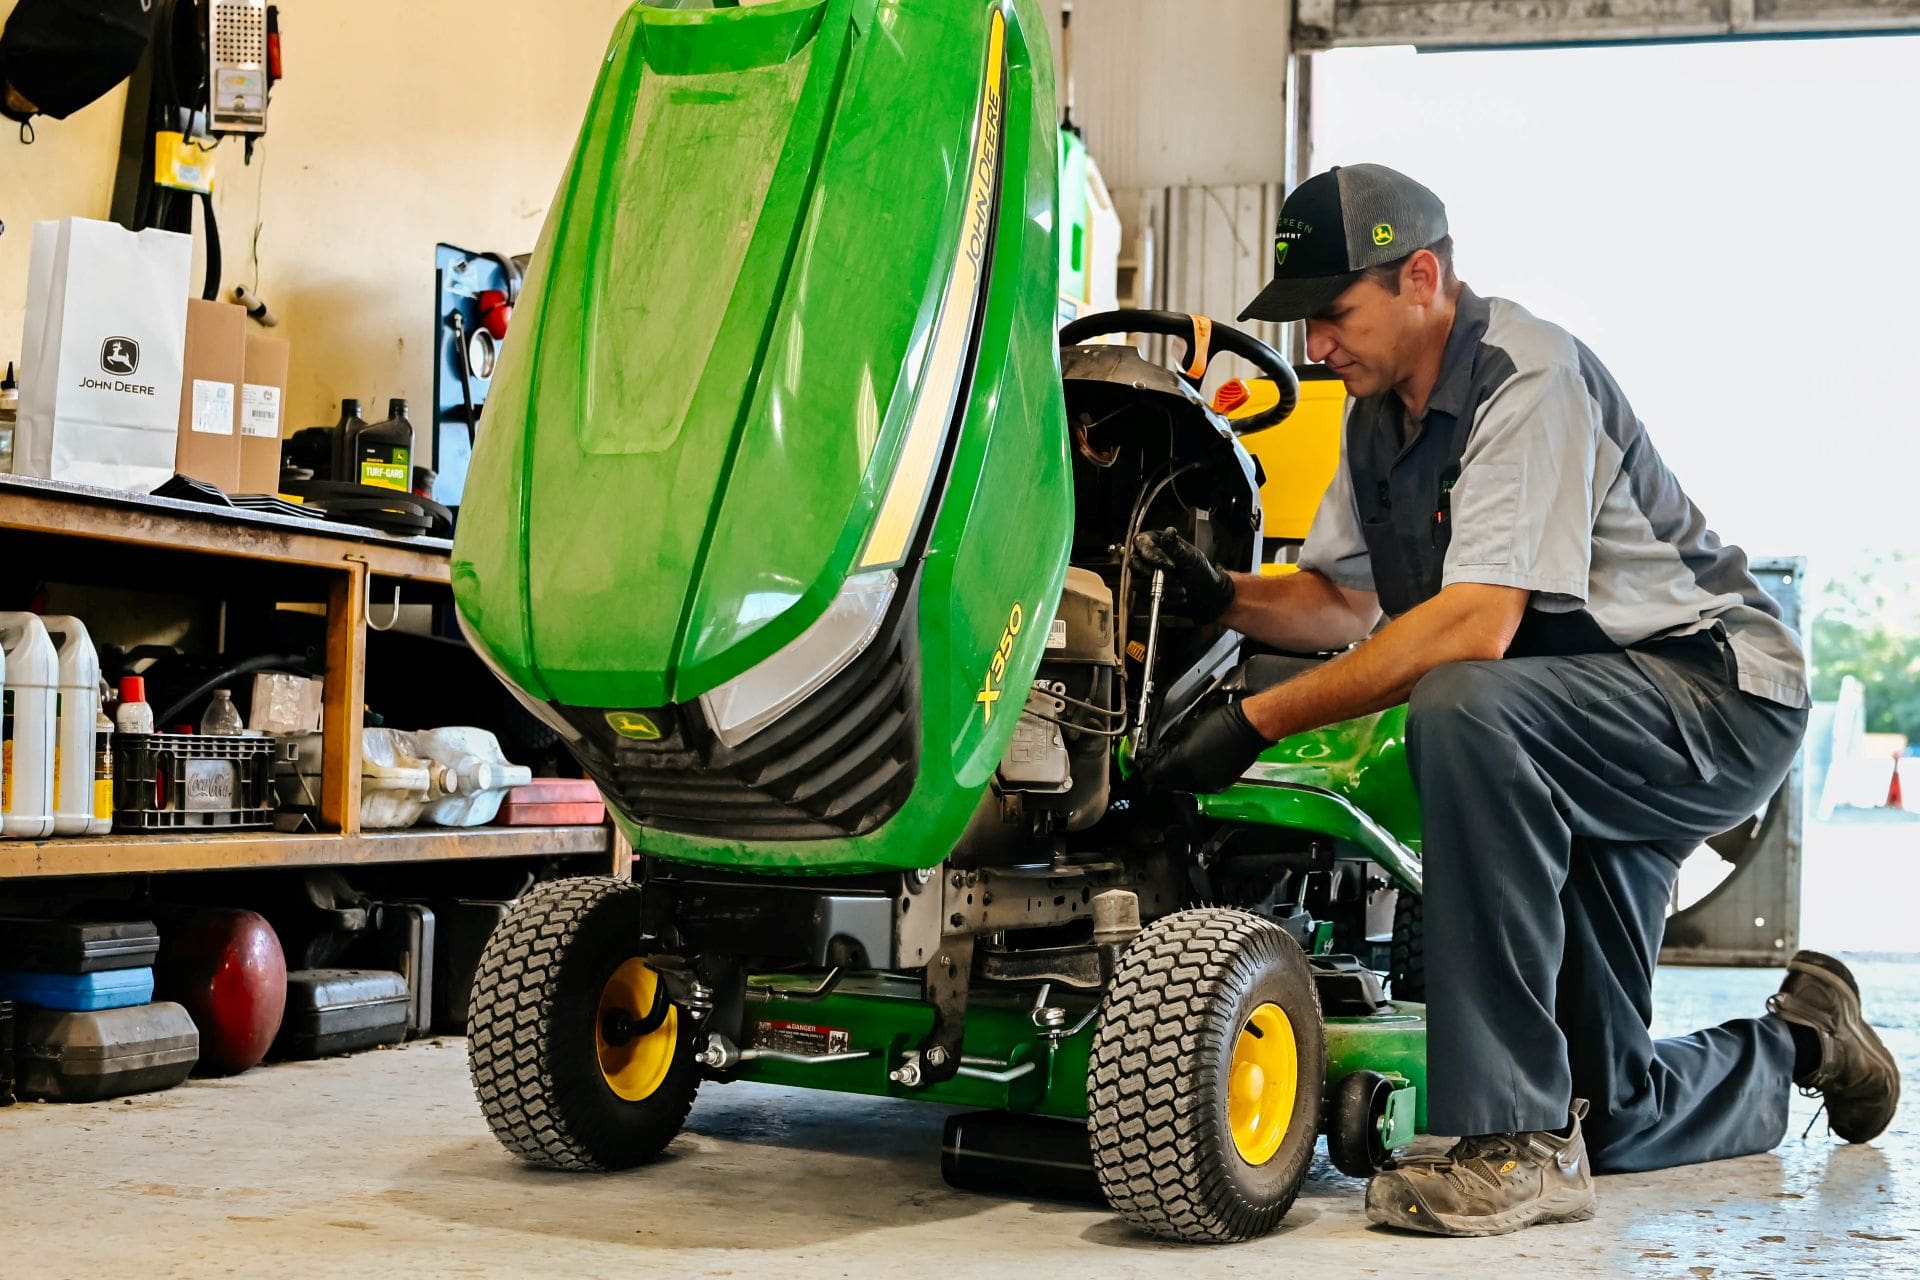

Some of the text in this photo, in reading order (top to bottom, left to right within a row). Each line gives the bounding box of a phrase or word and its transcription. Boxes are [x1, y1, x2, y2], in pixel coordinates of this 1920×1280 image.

[966, 86, 1000, 281] JOHN DEERE
[79, 377, 156, 396] JOHN DEERE
[366, 466, 404, 479] TURF-GARD
[976, 601, 1022, 729] X350
[791, 1023, 816, 1032] DANGER
